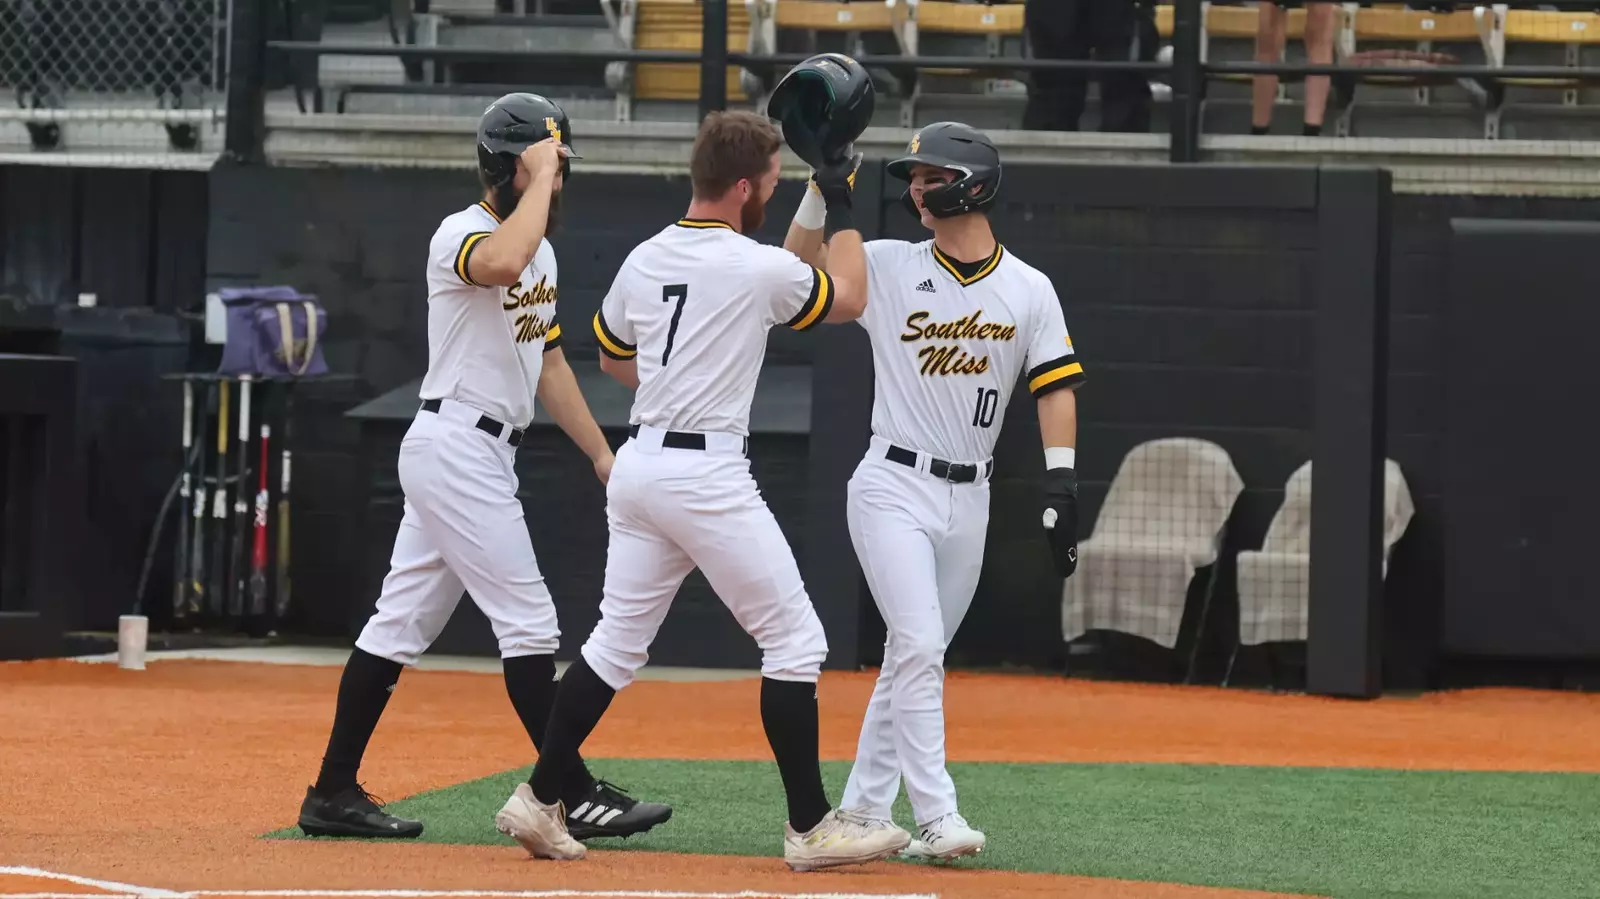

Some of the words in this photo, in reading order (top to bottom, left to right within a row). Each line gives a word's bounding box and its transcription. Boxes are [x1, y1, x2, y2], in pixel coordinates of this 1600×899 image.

[661, 283, 688, 367] 7
[900, 309, 1017, 342] Southern
[918, 345, 988, 376] Miss
[972, 387, 999, 429] 10
